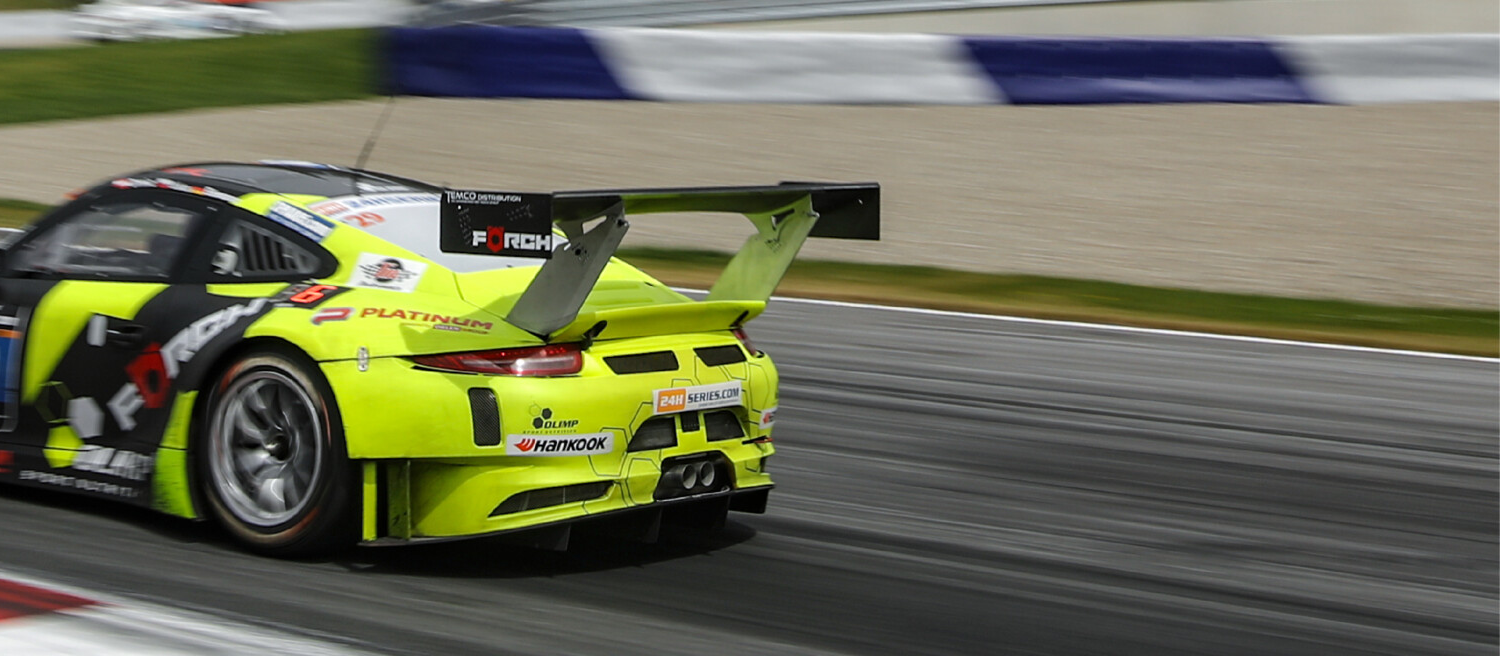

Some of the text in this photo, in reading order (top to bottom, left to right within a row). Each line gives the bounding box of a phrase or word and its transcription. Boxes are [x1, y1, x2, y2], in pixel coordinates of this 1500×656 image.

[445, 191, 476, 203] TEMCO
[478, 194, 521, 202] DISTRIBUTION
[359, 307, 493, 330] PLATINUM
[660, 393, 685, 407] 24H
[688, 387, 740, 403] SERIES.COM
[544, 419, 579, 429] OLIMP
